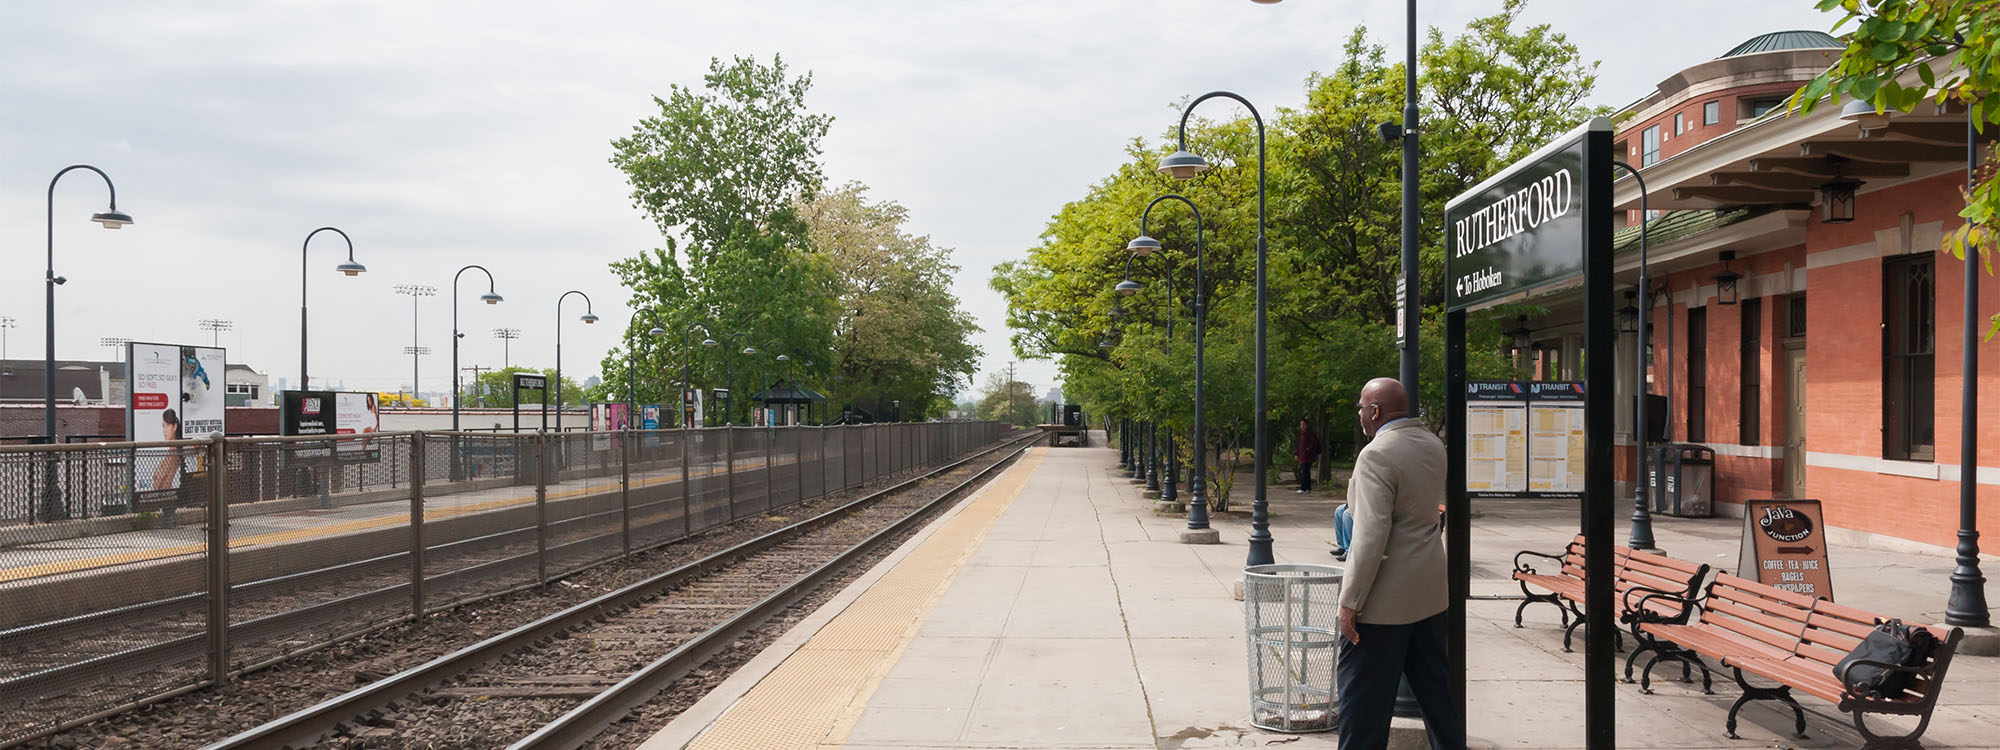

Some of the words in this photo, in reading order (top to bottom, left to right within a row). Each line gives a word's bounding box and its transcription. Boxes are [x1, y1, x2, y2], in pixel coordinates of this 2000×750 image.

[1455, 168, 1572, 258] RUTHERFORD
[1464, 274, 1473, 295] To
[1472, 266, 1502, 293] Hoboken
[1468, 383, 1478, 393] NJ
[1530, 383, 1540, 393] NJ
[1767, 528, 1810, 541] JUNCTION
[1763, 560, 1784, 570] COFFEE
[1787, 560, 1799, 570] TEA
[1802, 560, 1819, 570] JUICE
[1781, 572, 1804, 581] BAGELS
